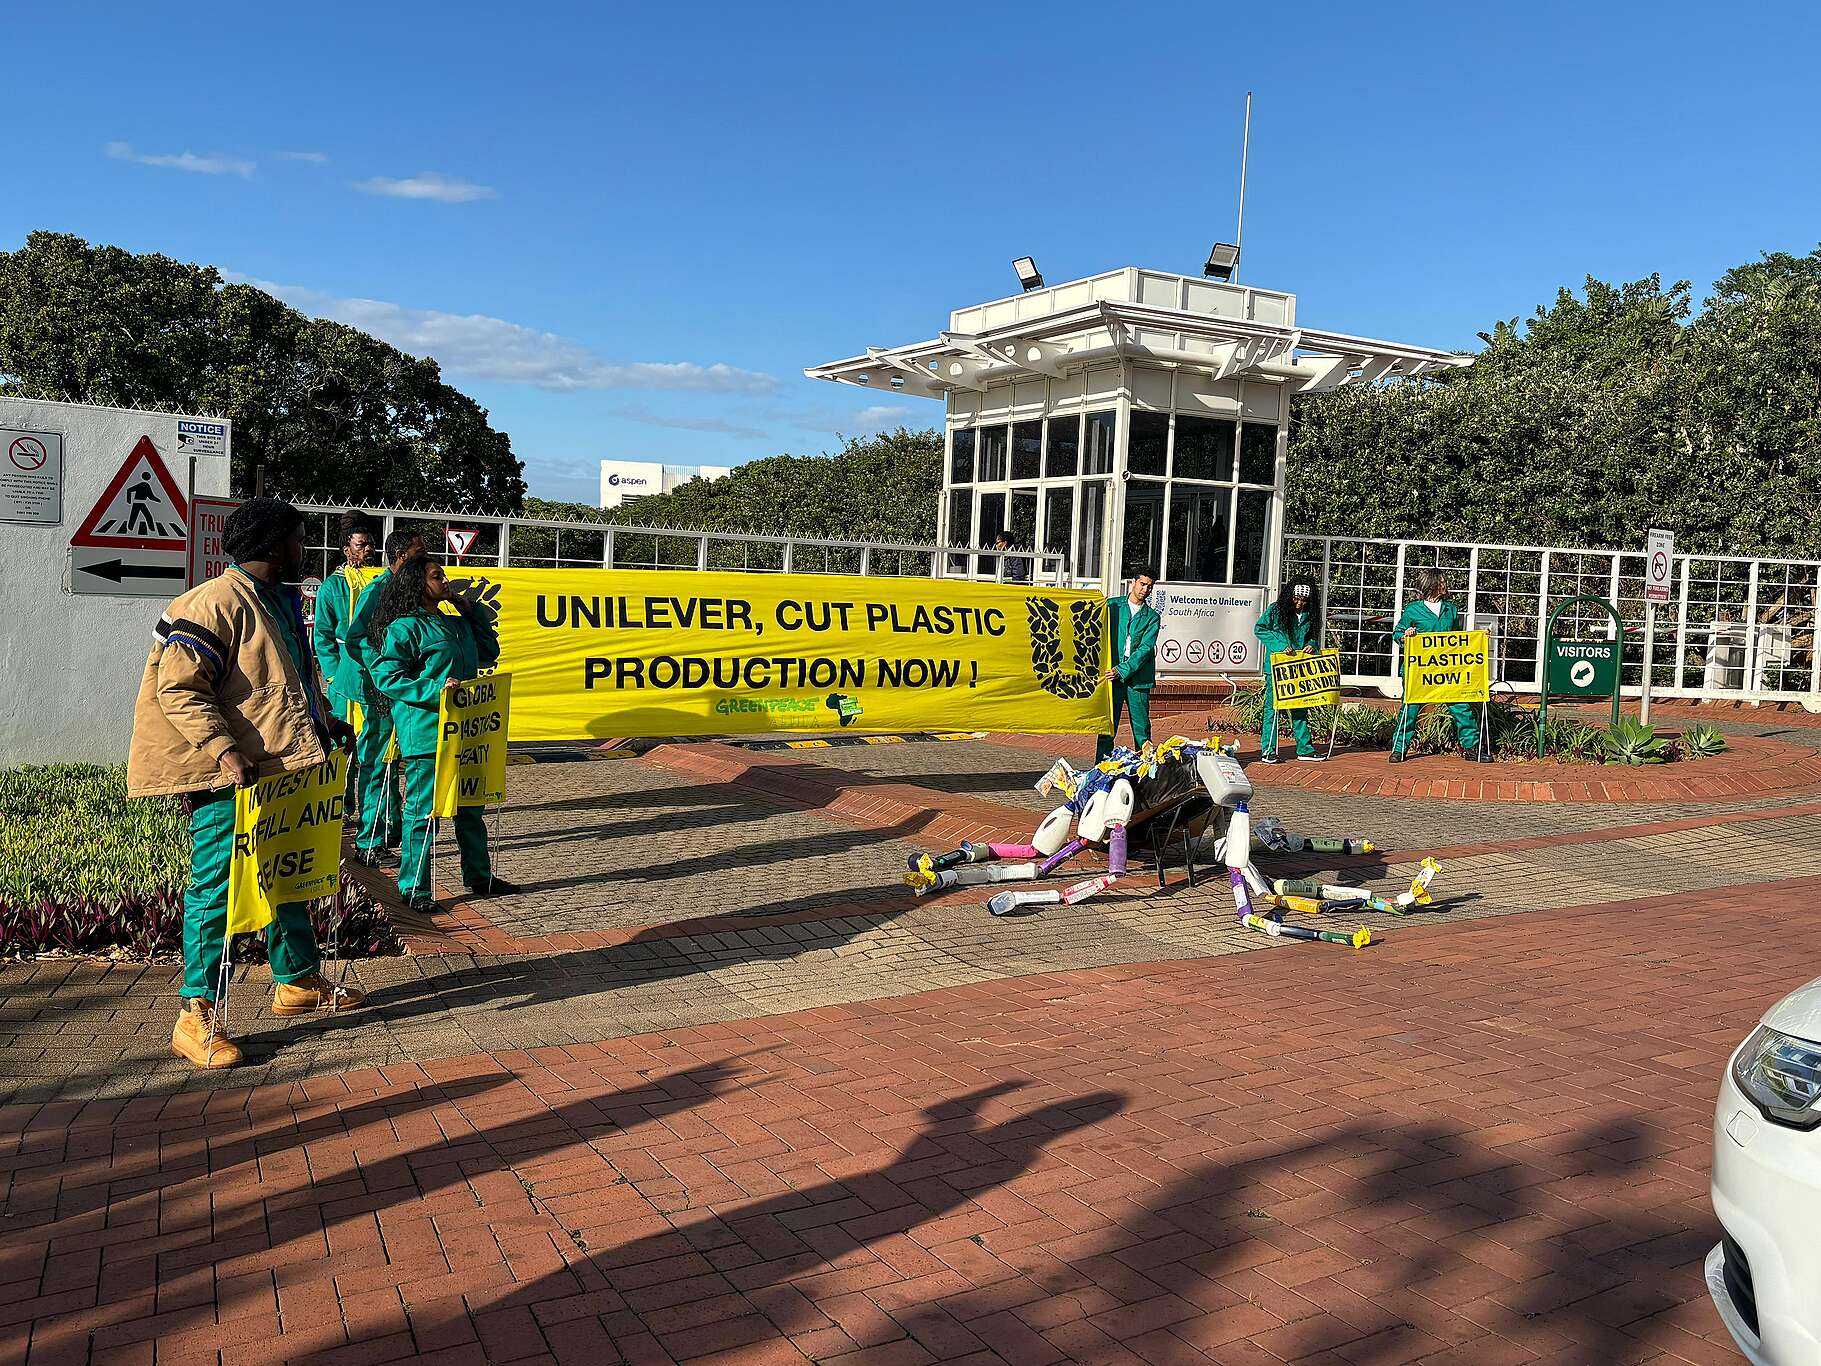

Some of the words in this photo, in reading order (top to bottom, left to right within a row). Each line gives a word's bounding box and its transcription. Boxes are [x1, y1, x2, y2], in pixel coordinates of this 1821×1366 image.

[181, 422, 222, 434] NOTICE
[620, 477, 647, 486] aspen
[1170, 595, 1208, 605] Welcome
[1209, 596, 1218, 605] to
[1218, 598, 1252, 606] Unilever
[536, 595, 763, 635] UNILEVER,
[775, 600, 854, 632] CUT
[866, 603, 1006, 636] PLASTIC
[1168, 608, 1192, 616] South
[1193, 608, 1215, 618] Africa
[1422, 634, 1469, 648] DITCH
[1232, 646, 1243, 654] 20
[1557, 646, 1611, 658] VISITORS
[1408, 653, 1484, 667] PLASTICS
[584, 655, 865, 690] PRODUCTION
[877, 658, 960, 688] NOW
[1276, 658, 1337, 682] RETURN
[1422, 672, 1460, 686] NOW
[1278, 683, 1296, 696] TO
[716, 697, 820, 715] GREENPEACE
[249, 766, 318, 814] INVEST
[318, 757, 339, 786] IN
[296, 795, 344, 829] AND
